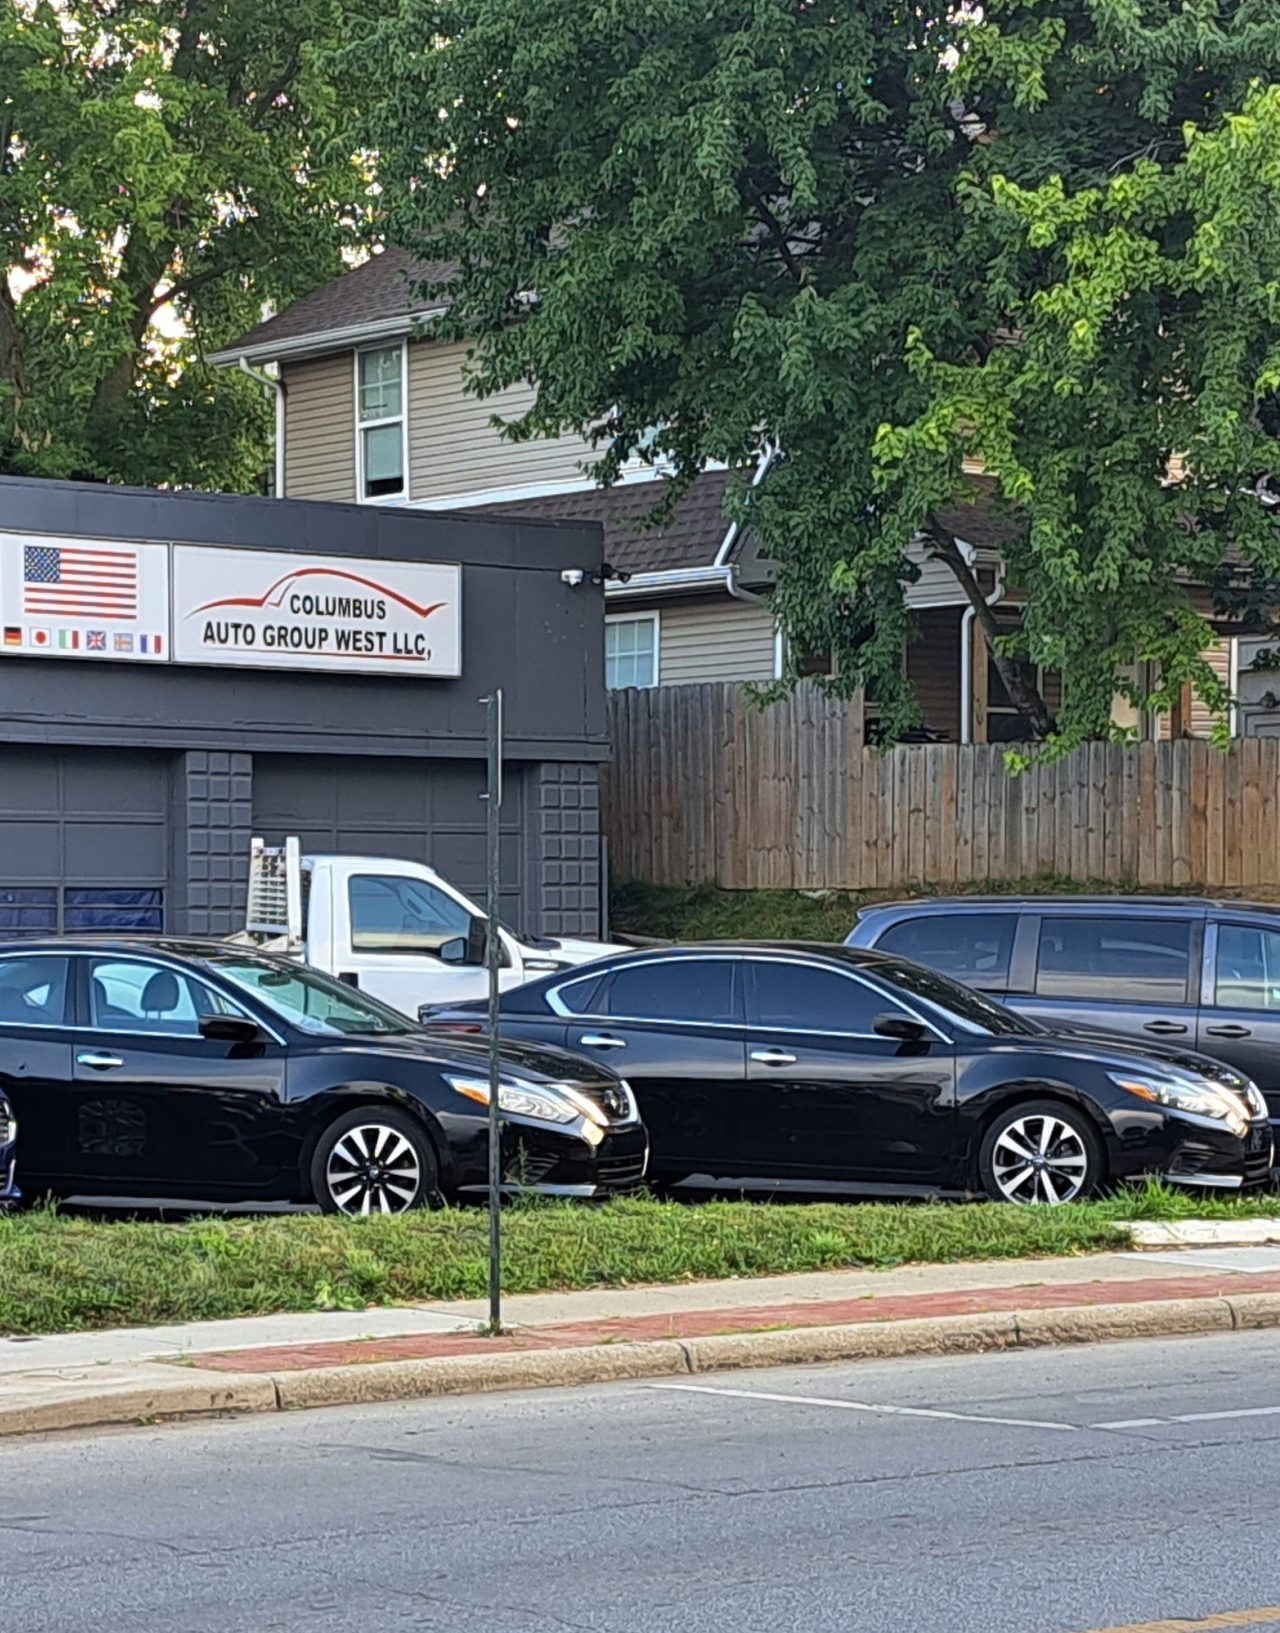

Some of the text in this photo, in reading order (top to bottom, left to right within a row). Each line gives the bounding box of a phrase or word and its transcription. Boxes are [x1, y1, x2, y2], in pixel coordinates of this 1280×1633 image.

[290, 594, 386, 620] COLUMBUS
[203, 621, 256, 645] AUTO
[263, 624, 329, 650] GROUP
[335, 628, 387, 653] WEST
